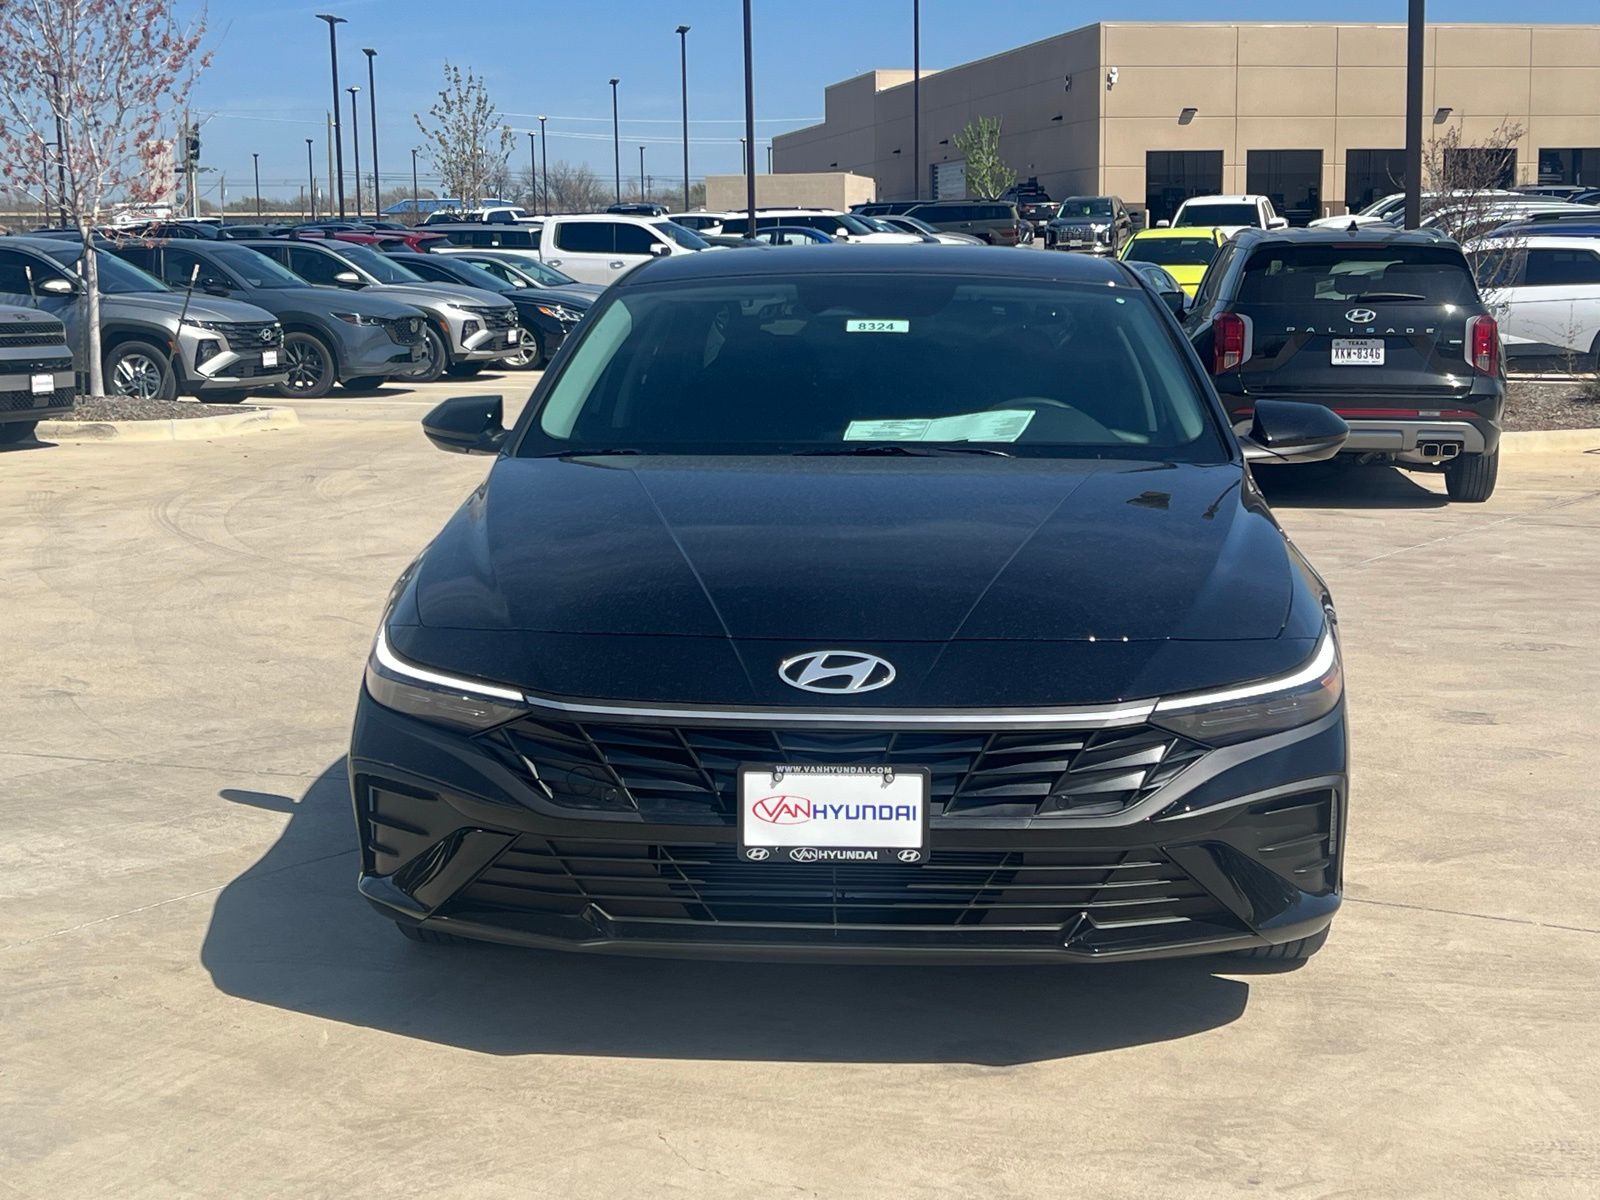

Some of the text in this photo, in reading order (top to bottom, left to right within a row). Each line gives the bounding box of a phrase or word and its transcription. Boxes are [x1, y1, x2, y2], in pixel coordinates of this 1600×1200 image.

[858, 322, 895, 331] 8324
[1286, 326, 1435, 334] PALISADE
[776, 765, 893, 774] WWW.VANHYUNDAI.COM
[812, 804, 917, 821] HYUNDAI
